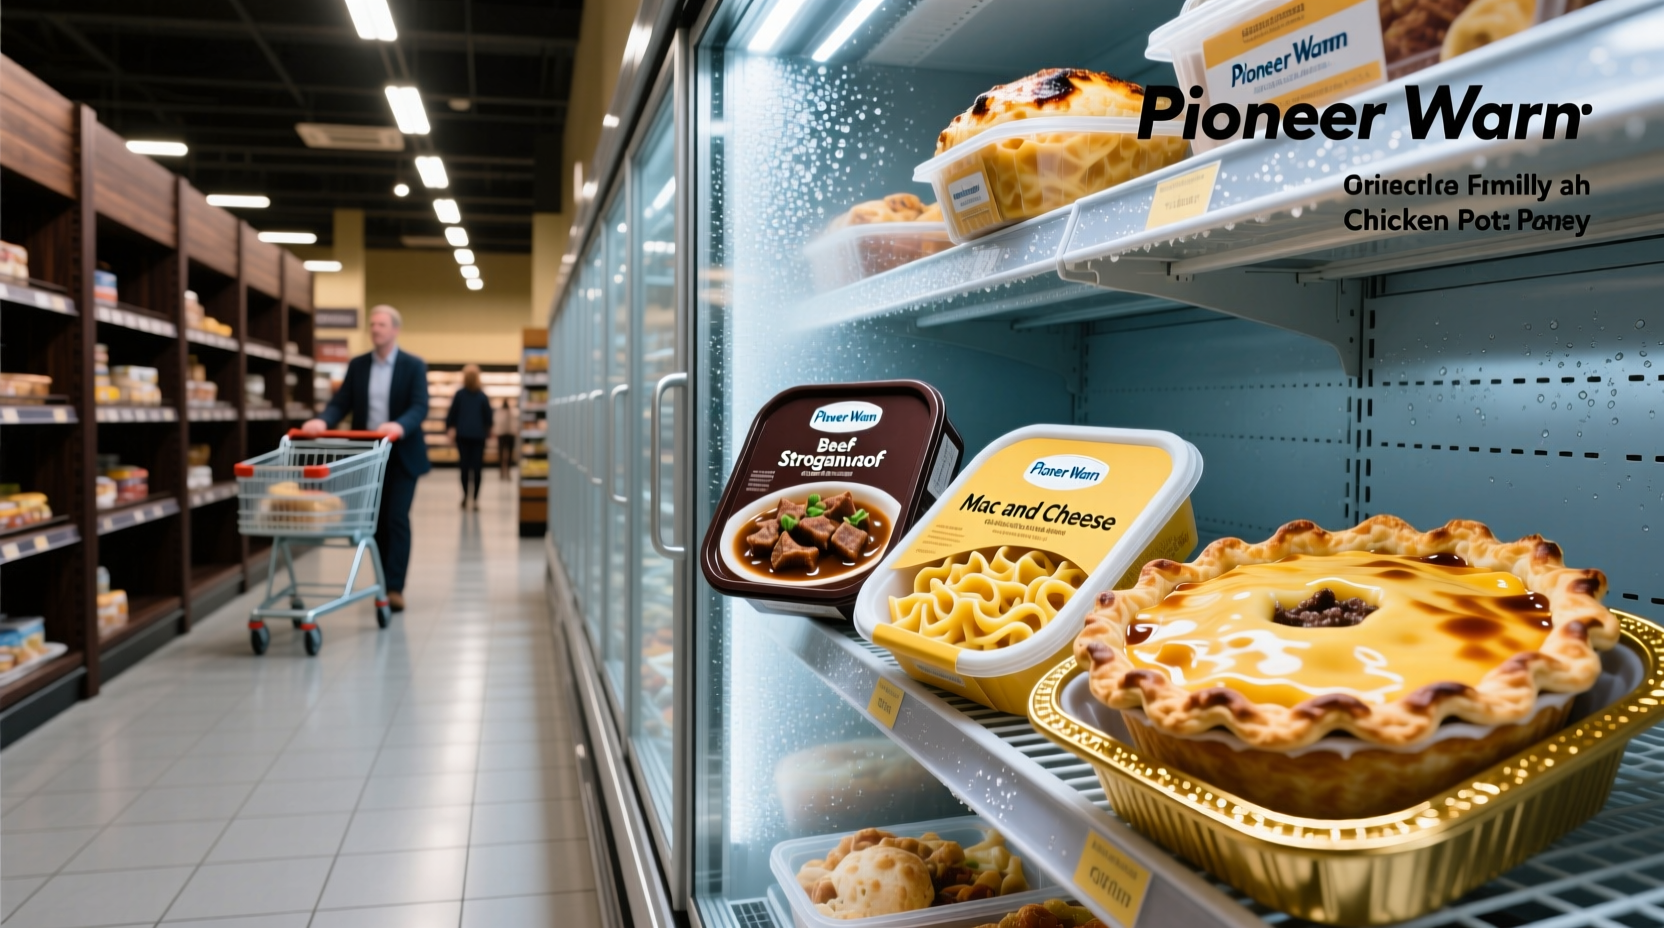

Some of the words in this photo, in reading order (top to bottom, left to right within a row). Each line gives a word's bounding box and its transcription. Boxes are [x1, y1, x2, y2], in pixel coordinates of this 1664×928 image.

[816, 436, 858, 453] Beef
[959, 492, 1002, 514] Mac
[1001, 501, 1045, 520] and
[1042, 503, 1117, 532] Cheese
